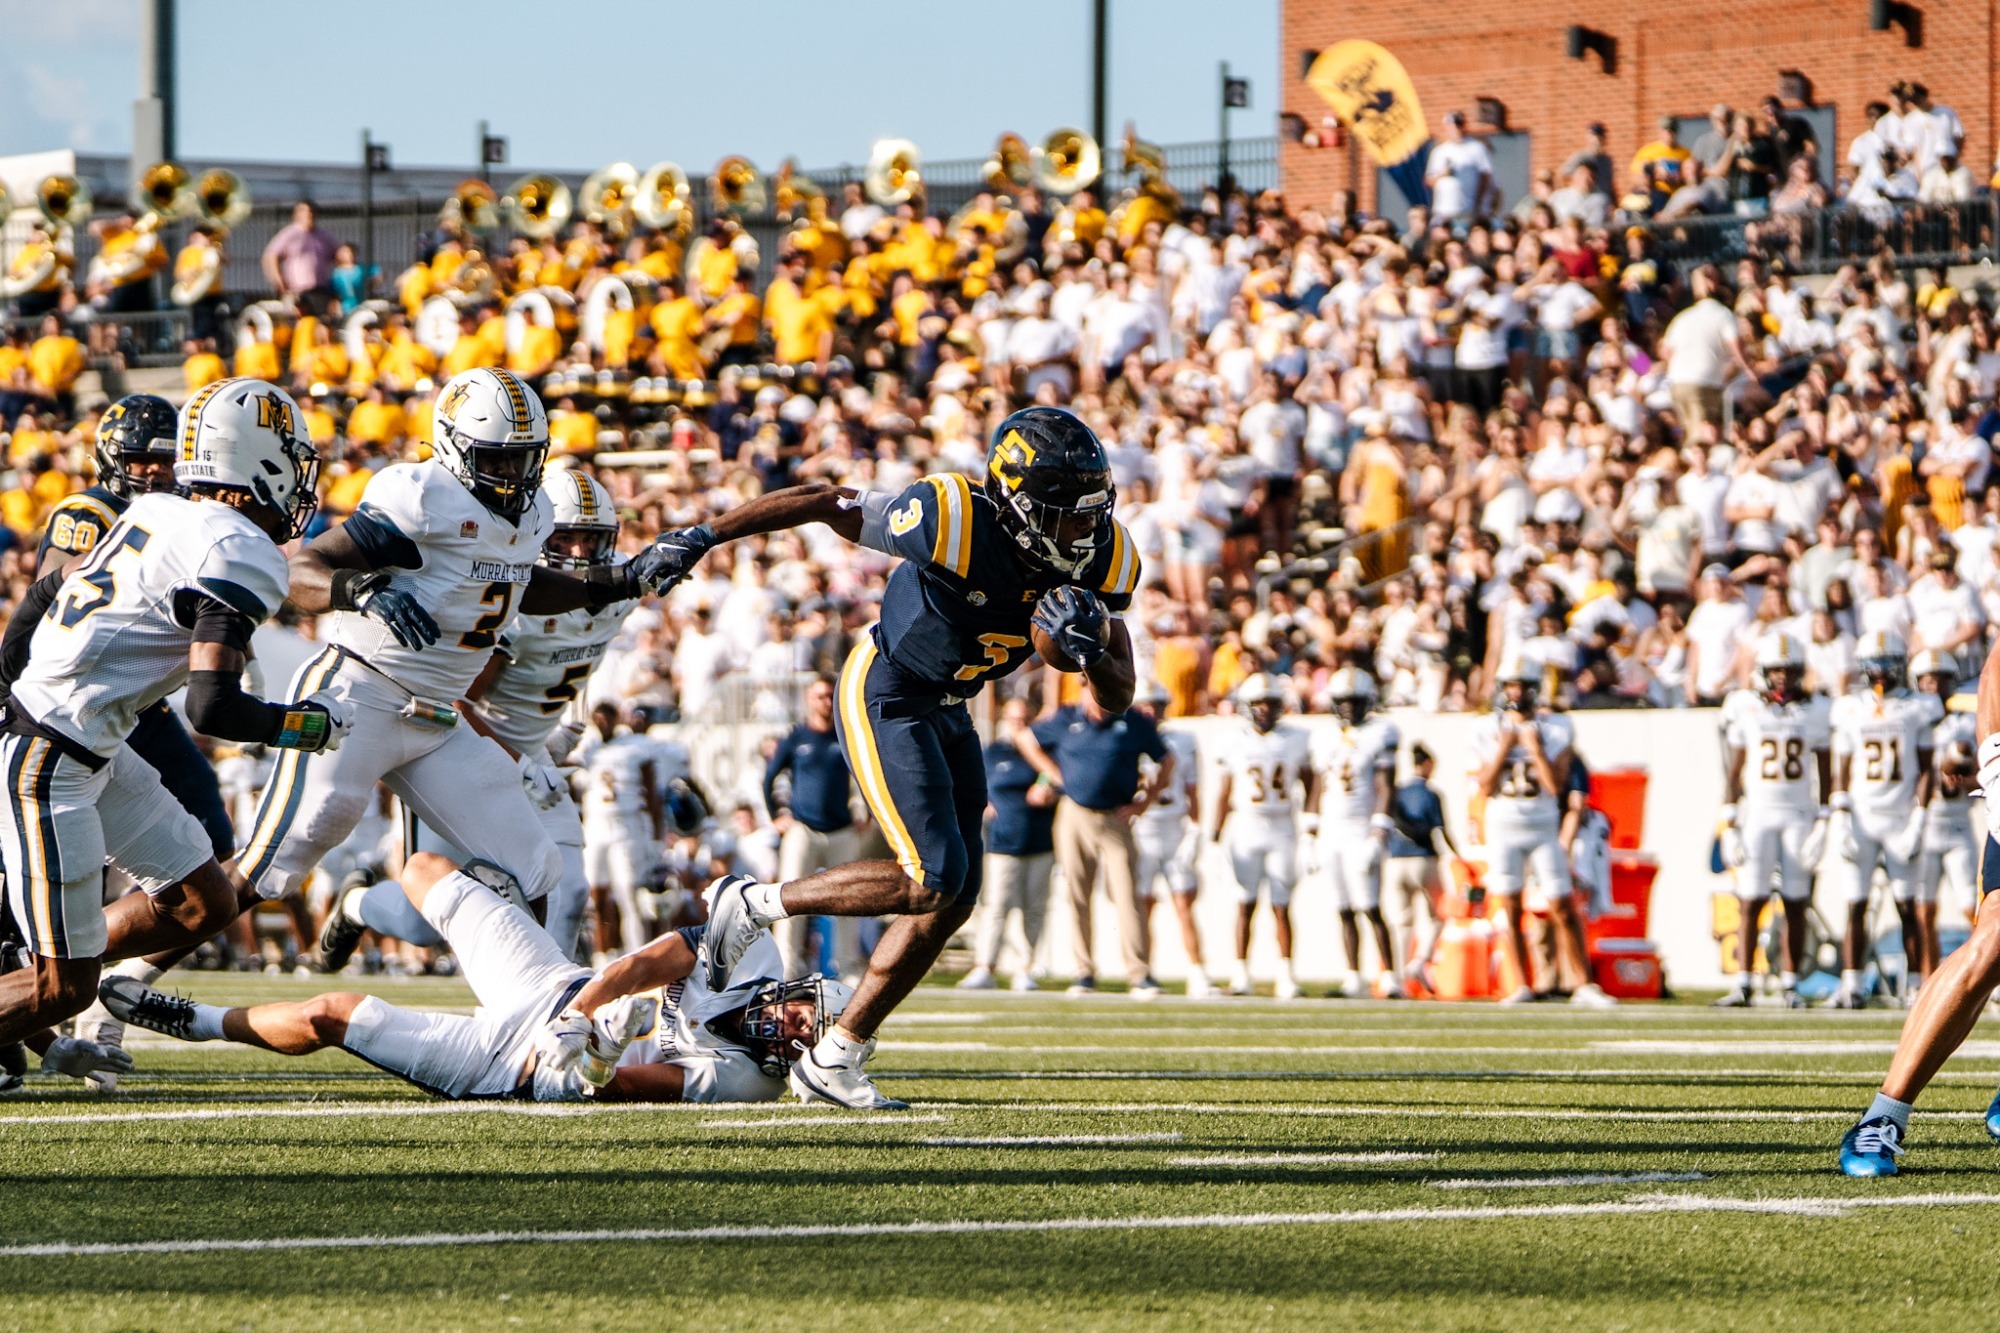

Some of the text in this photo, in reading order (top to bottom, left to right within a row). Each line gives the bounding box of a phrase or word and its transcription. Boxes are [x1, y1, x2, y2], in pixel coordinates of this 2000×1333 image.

[190, 464, 217, 478] STATE
[203, 450, 212, 462] 15
[51, 513, 99, 553] 60
[889, 498, 923, 537] 3
[470, 560, 510, 582] MURRAY
[457, 581, 513, 651] 2
[1021, 590, 1037, 603] E
[549, 645, 588, 665] MURRAY
[540, 661, 593, 716] 5
[1760, 737, 1804, 781] 28
[1864, 737, 1903, 782] 21
[1246, 763, 1287, 803] 34
[660, 1023, 682, 1059] STATE
